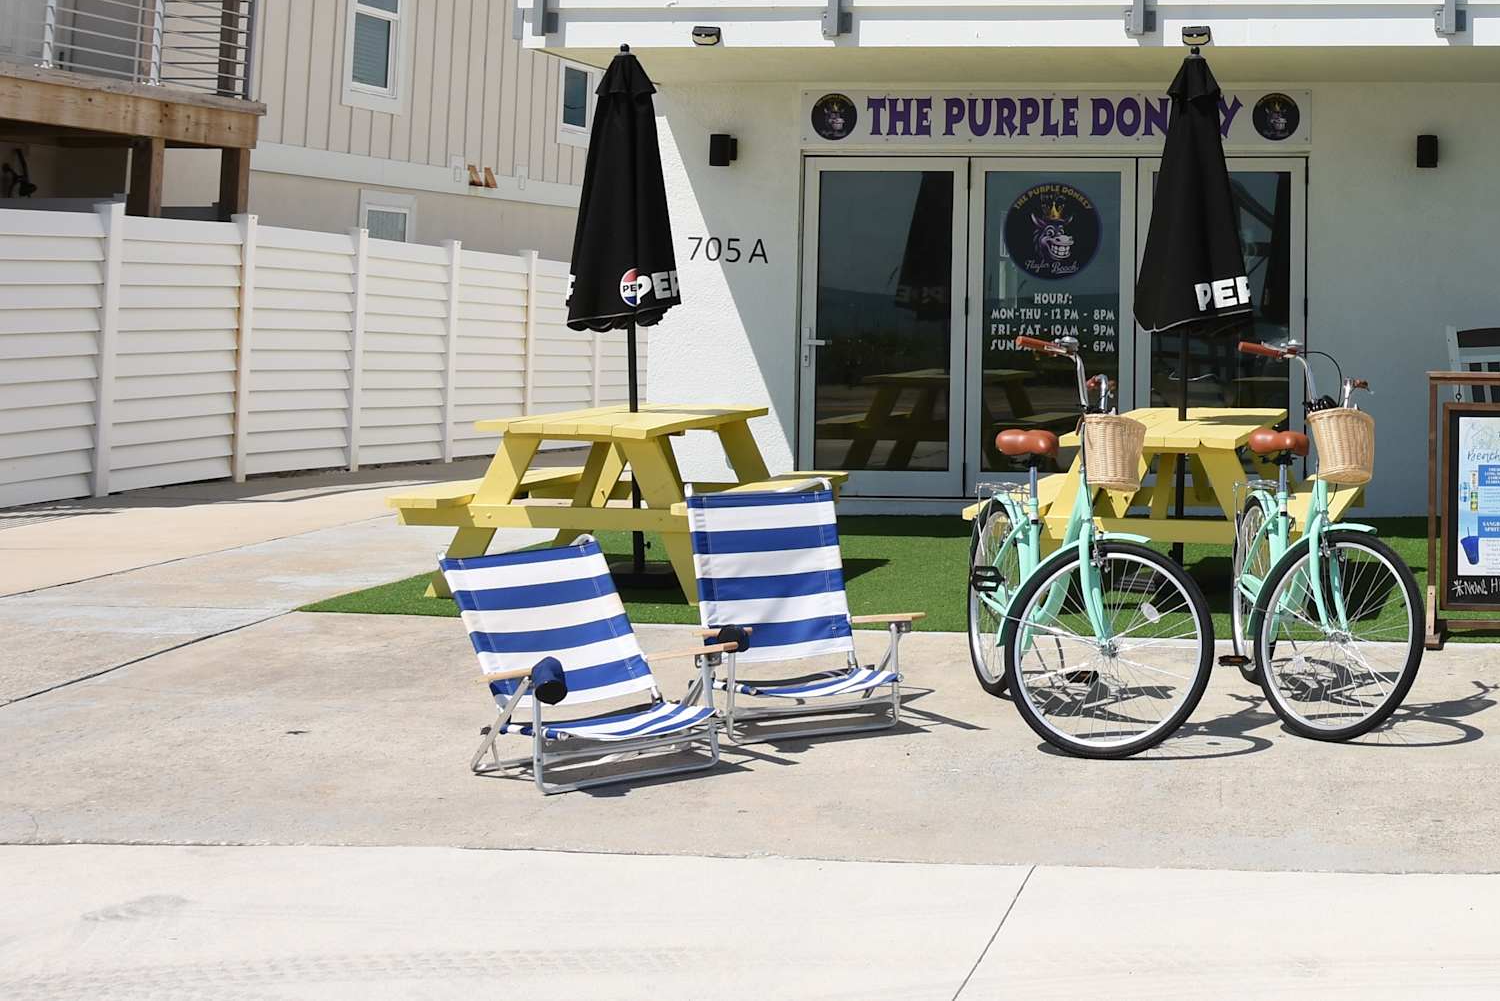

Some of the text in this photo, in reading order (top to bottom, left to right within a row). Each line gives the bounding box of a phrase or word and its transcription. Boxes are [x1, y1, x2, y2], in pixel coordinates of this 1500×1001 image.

[866, 95, 1243, 139] THE PURPLE DONY
[1029, 185, 1061, 200] PURPLE
[687, 236, 769, 264] 705A
[1034, 292, 1073, 304] HOURS:
[1093, 309, 1115, 321] 8PM
[1050, 324, 1079, 336] 10AM
[1093, 324, 1115, 336] 9PM
[1093, 340, 1115, 352] 6PM
